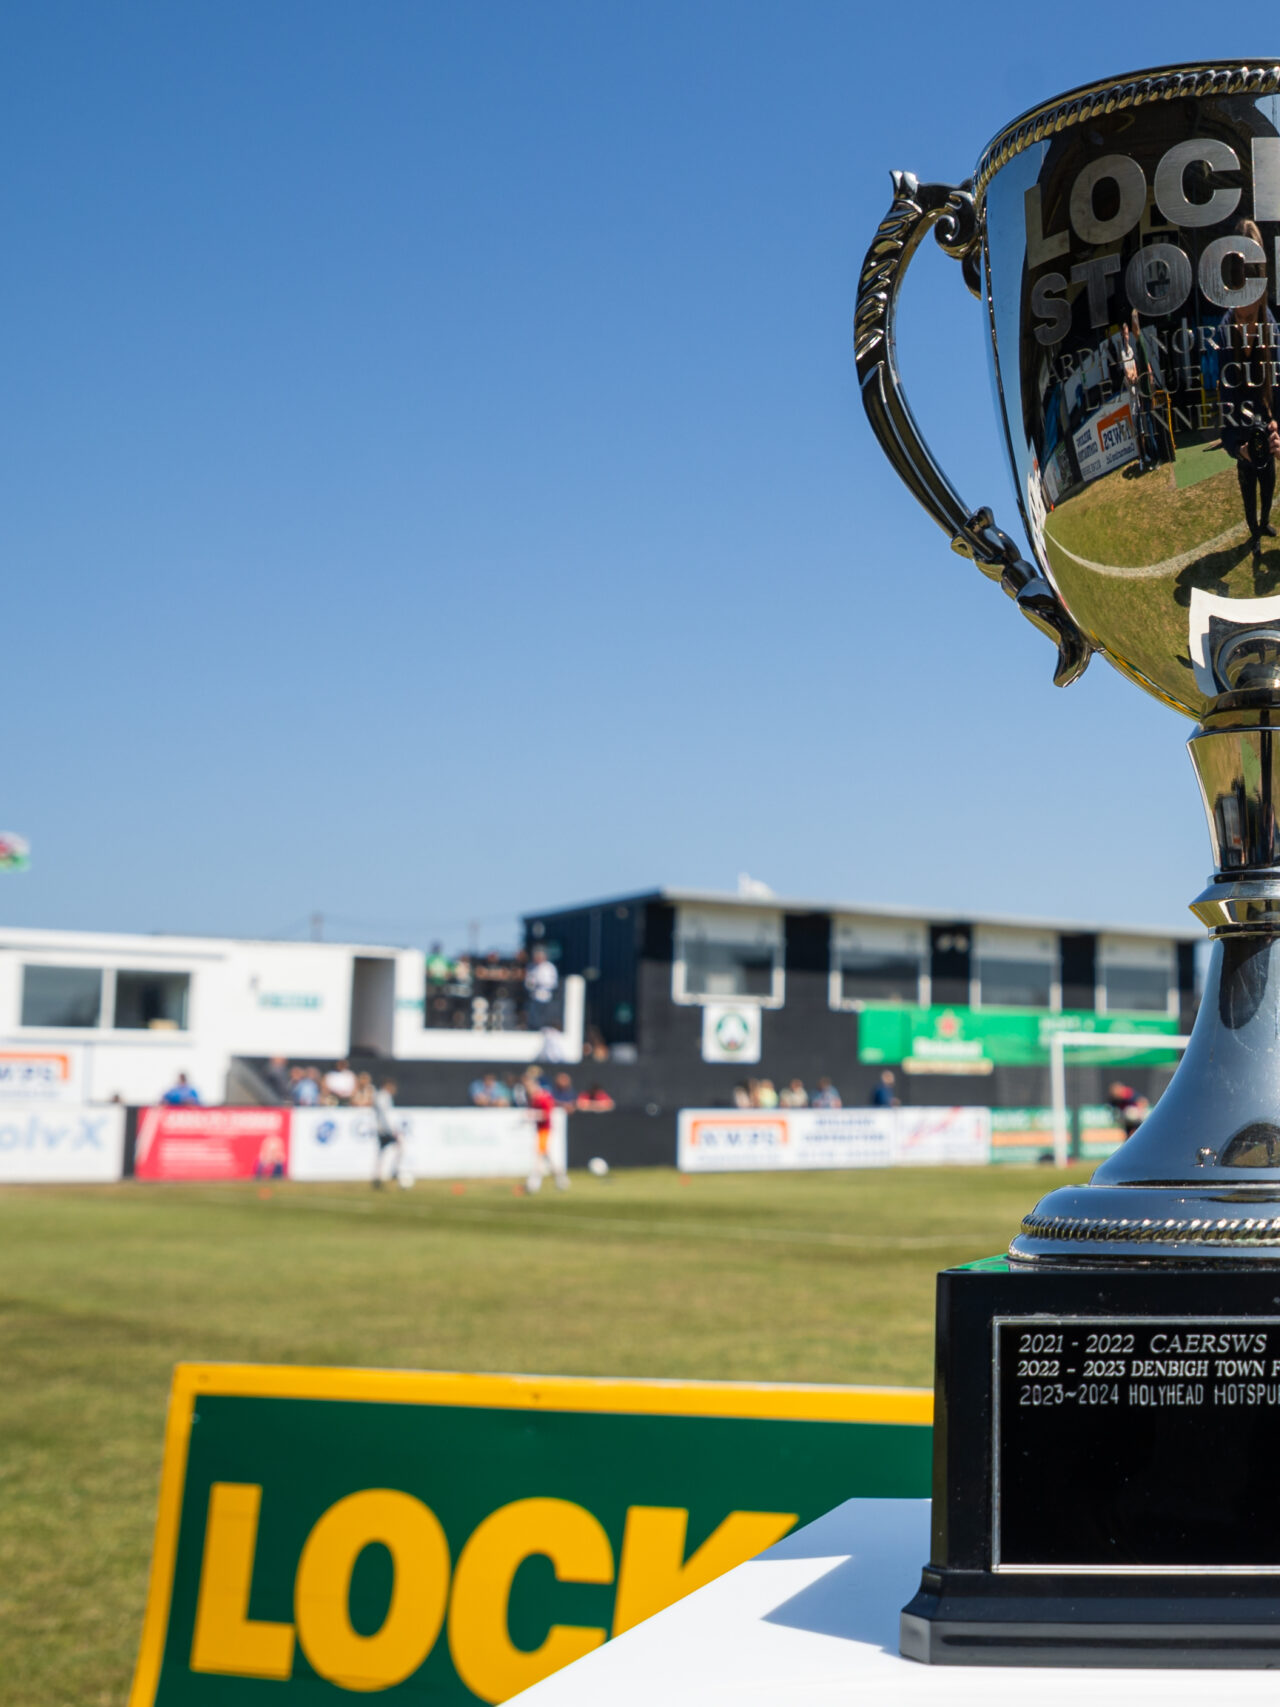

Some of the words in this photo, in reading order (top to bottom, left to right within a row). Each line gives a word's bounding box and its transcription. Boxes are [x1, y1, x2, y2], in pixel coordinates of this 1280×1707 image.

[1018, 1333, 1064, 1354] 2021
[1085, 1333, 1136, 1354] 2022
[1149, 1333, 1268, 1354] CAERSWS
[1016, 1360, 1060, 1377] 2022
[1083, 1360, 1126, 1377] 2023
[1131, 1360, 1209, 1377] DENBIGH
[1215, 1360, 1266, 1377] TOWN
[1128, 1384, 1204, 1405] HOLYHEAD
